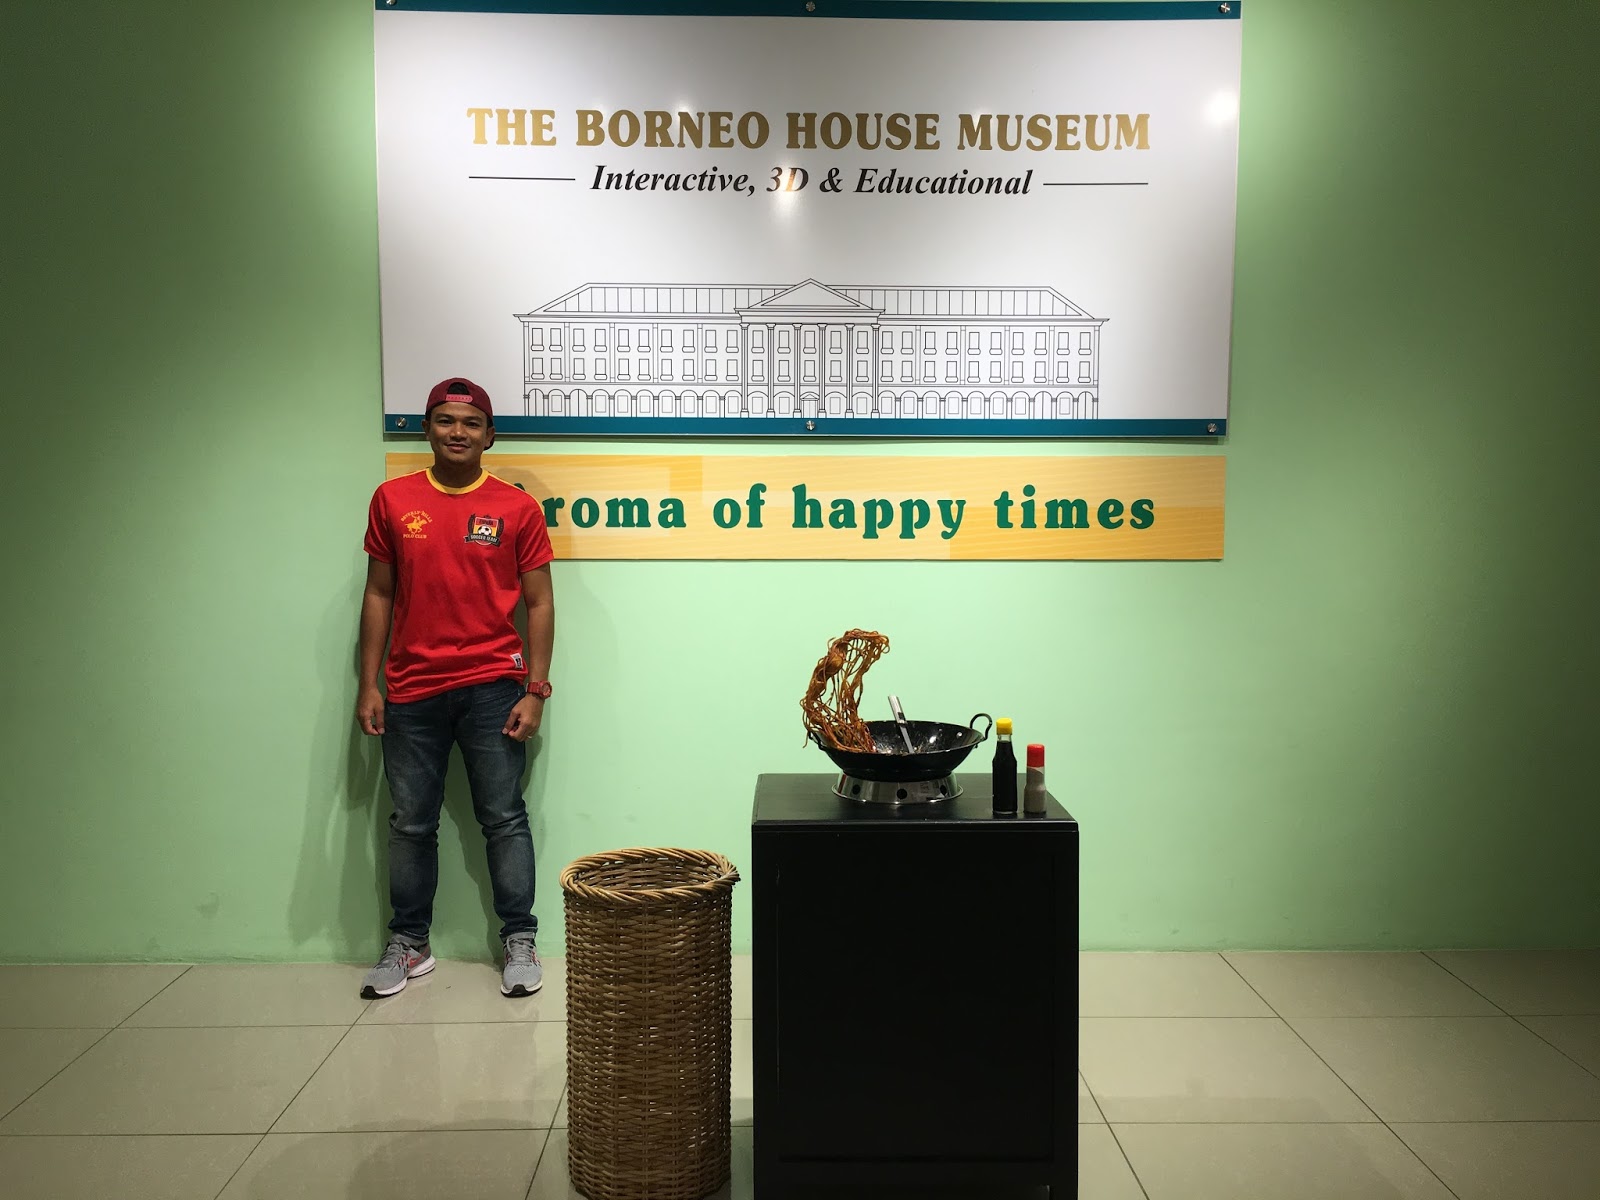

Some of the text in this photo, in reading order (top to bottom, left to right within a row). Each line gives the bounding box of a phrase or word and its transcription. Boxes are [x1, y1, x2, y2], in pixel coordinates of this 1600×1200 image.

[466, 108, 1151, 151] THE BORNEO HOUSE MUSEUM
[590, 165, 1034, 197] Interactive, 3D & Educational
[514, 483, 1154, 540] roma of happy times
